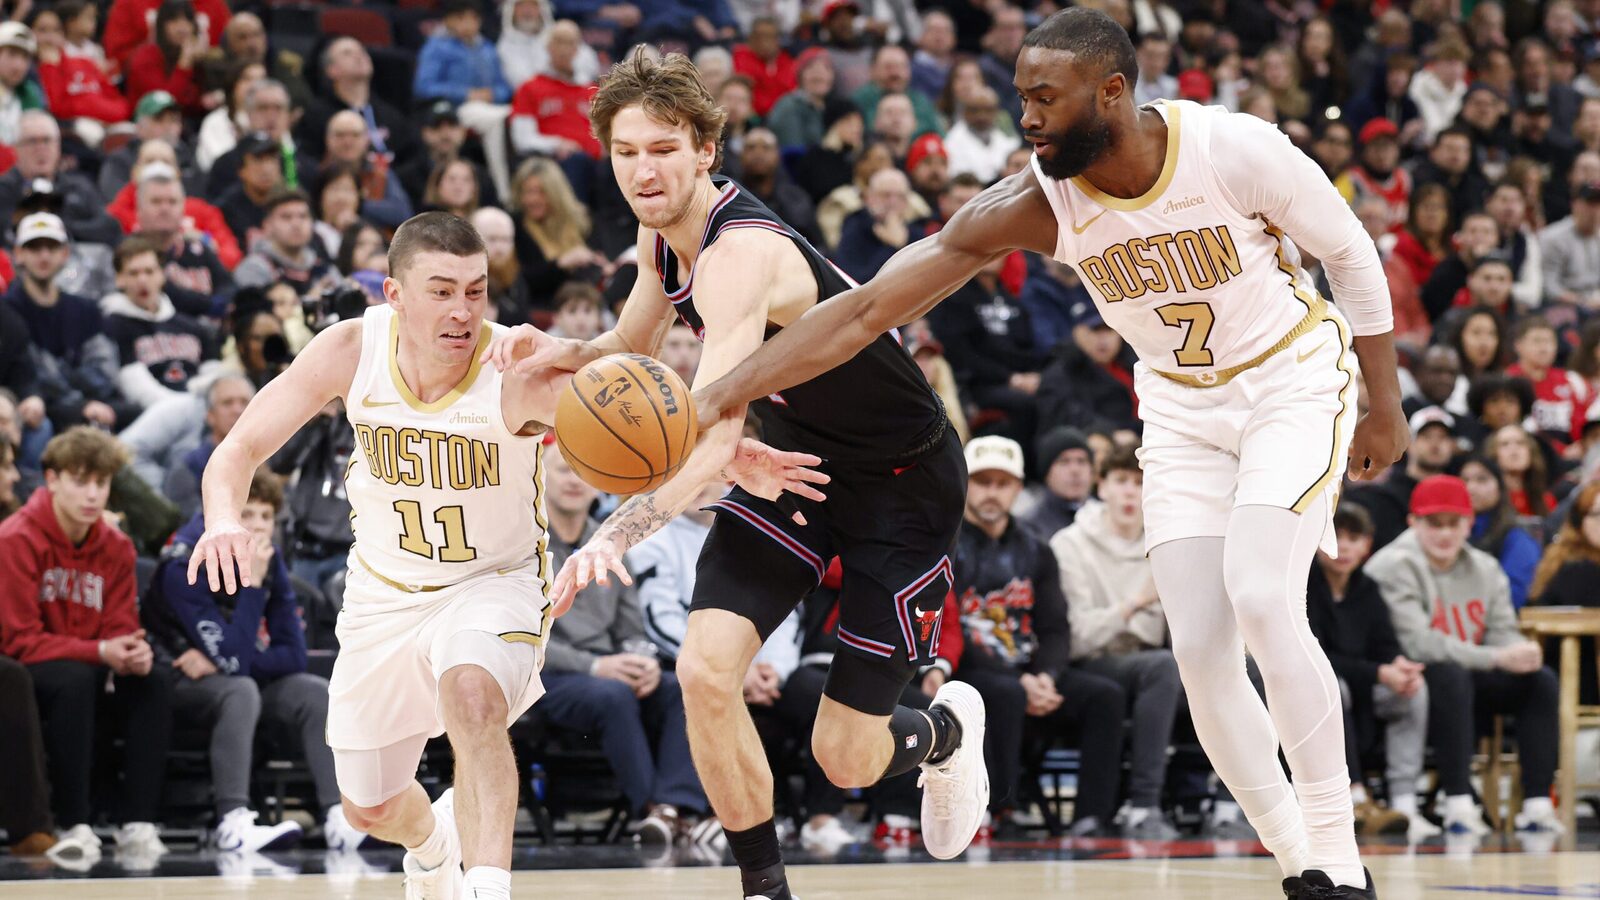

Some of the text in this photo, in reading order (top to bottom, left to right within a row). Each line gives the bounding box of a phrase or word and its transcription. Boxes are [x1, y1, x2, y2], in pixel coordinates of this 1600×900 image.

[1163, 195, 1205, 214] Amica
[1078, 225, 1243, 303] BOSTON
[1153, 301, 1216, 367] 7
[448, 410, 489, 425] Amica
[355, 423, 501, 490] BOSTON
[392, 499, 478, 563] 11
